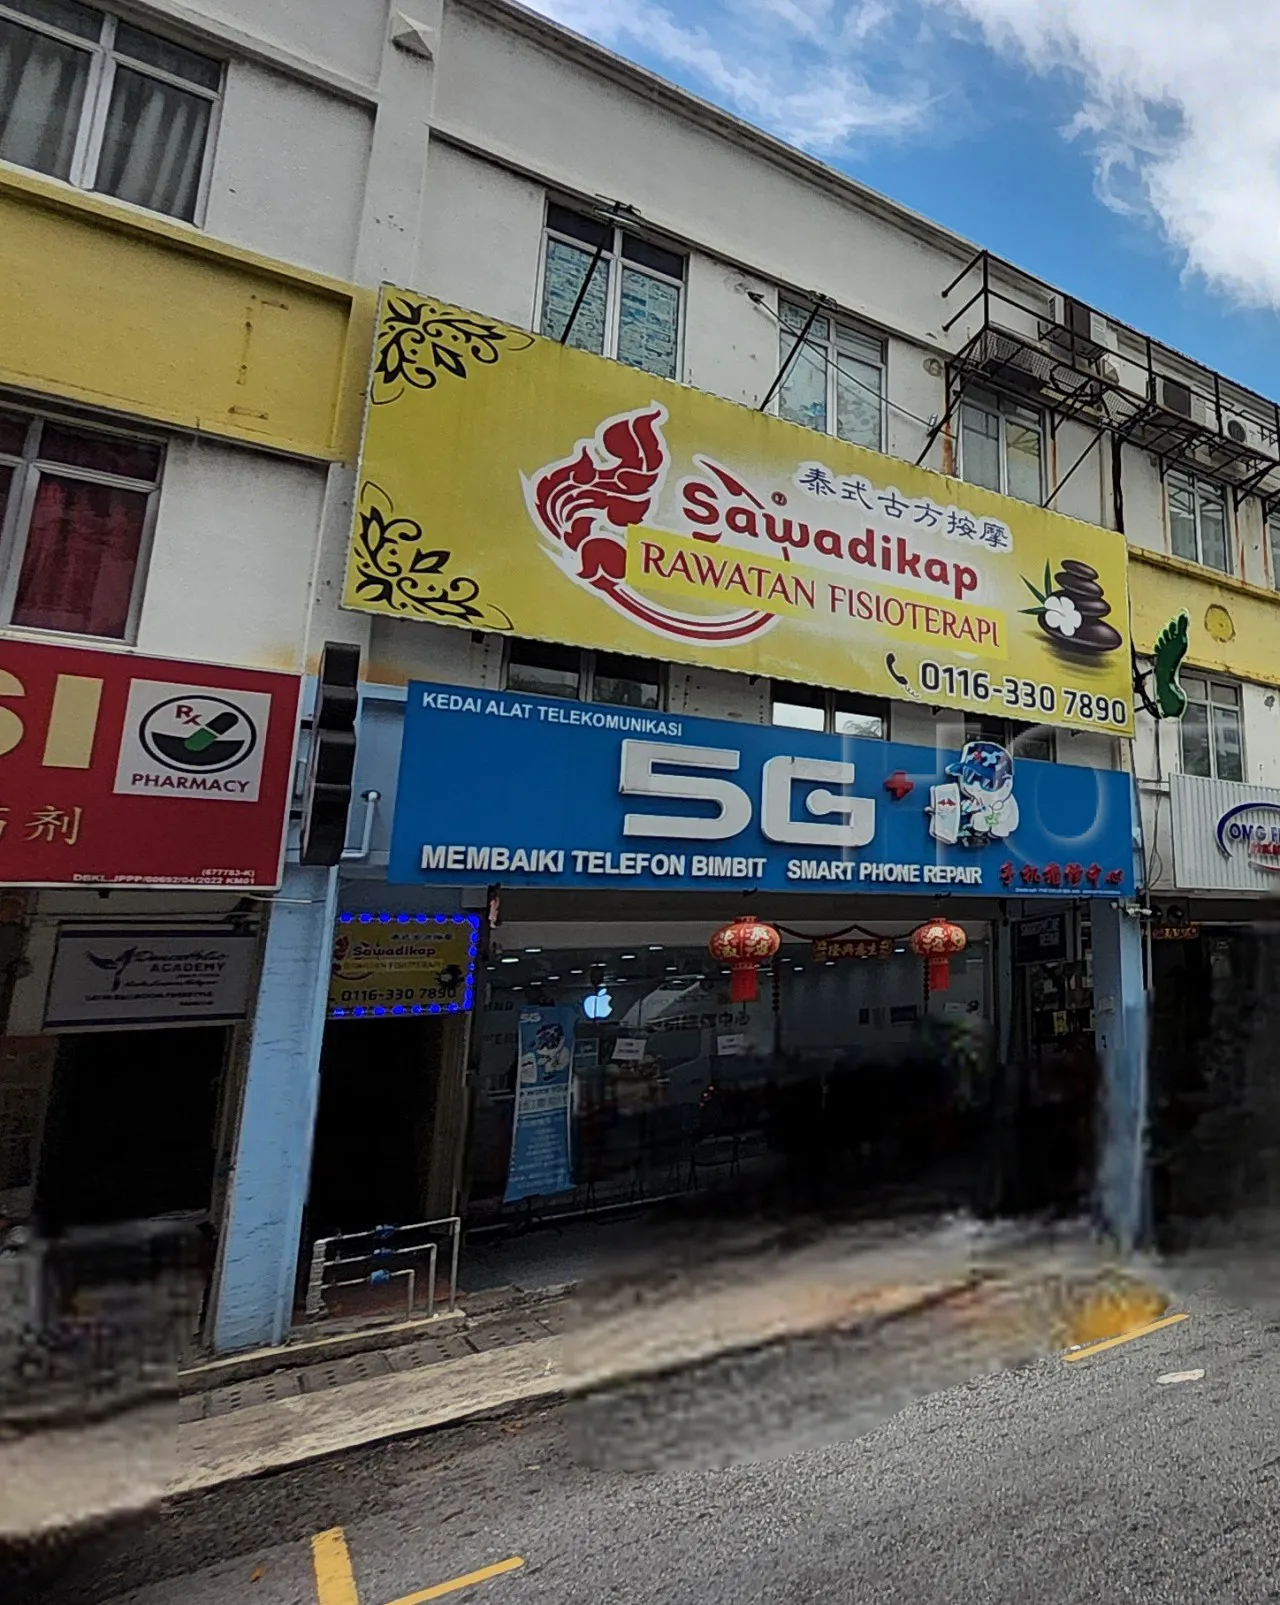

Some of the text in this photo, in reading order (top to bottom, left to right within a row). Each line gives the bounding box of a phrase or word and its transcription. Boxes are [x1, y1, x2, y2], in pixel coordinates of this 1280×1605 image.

[799, 467, 1009, 549] 泰式古方按摩
[682, 460, 979, 600] Sawadikap
[640, 541, 1001, 648] RAWATAN FISIOTERAPI
[921, 662, 1127, 724] 0116-330 7890
[422, 691, 683, 737] KEDAI ALAT TELEKOMUNIKASI
[130, 773, 251, 793] PHARMACY
[618, 738, 877, 848] 5G
[421, 844, 768, 879] MEMBAIKI TELEFON BIMBIT
[787, 858, 984, 885] SMART PHONE REPAIR
[149, 962, 227, 974] ACADEMY
[353, 945, 436, 958] Sawadikap
[341, 986, 457, 1002] 0116-330 7890
